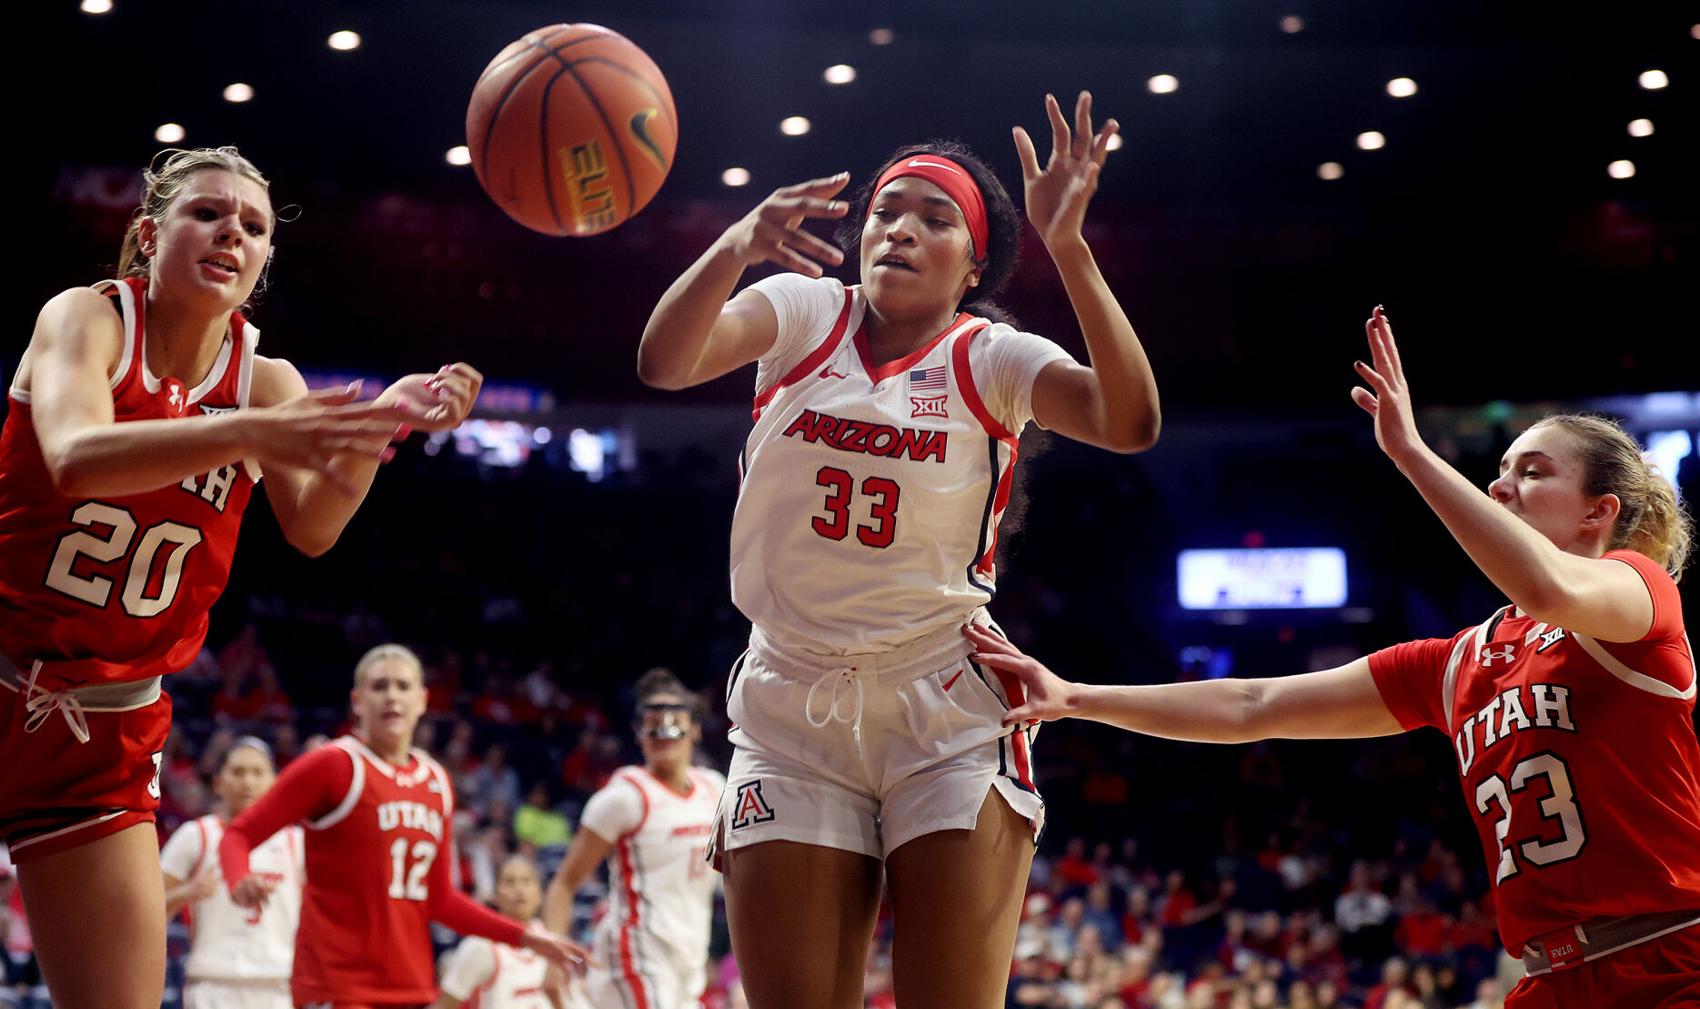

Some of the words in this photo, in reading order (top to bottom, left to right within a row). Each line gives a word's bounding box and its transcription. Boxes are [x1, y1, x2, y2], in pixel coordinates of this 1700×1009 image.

[568, 139, 615, 231] ELITE
[783, 409, 948, 463] ARIZONA
[910, 395, 949, 418] XII
[811, 466, 900, 548] 33
[44, 501, 203, 617] 20
[1455, 683, 1576, 778] UTAH
[732, 779, 775, 830] A
[1475, 752, 1586, 888] 23
[388, 837, 437, 901] 12
